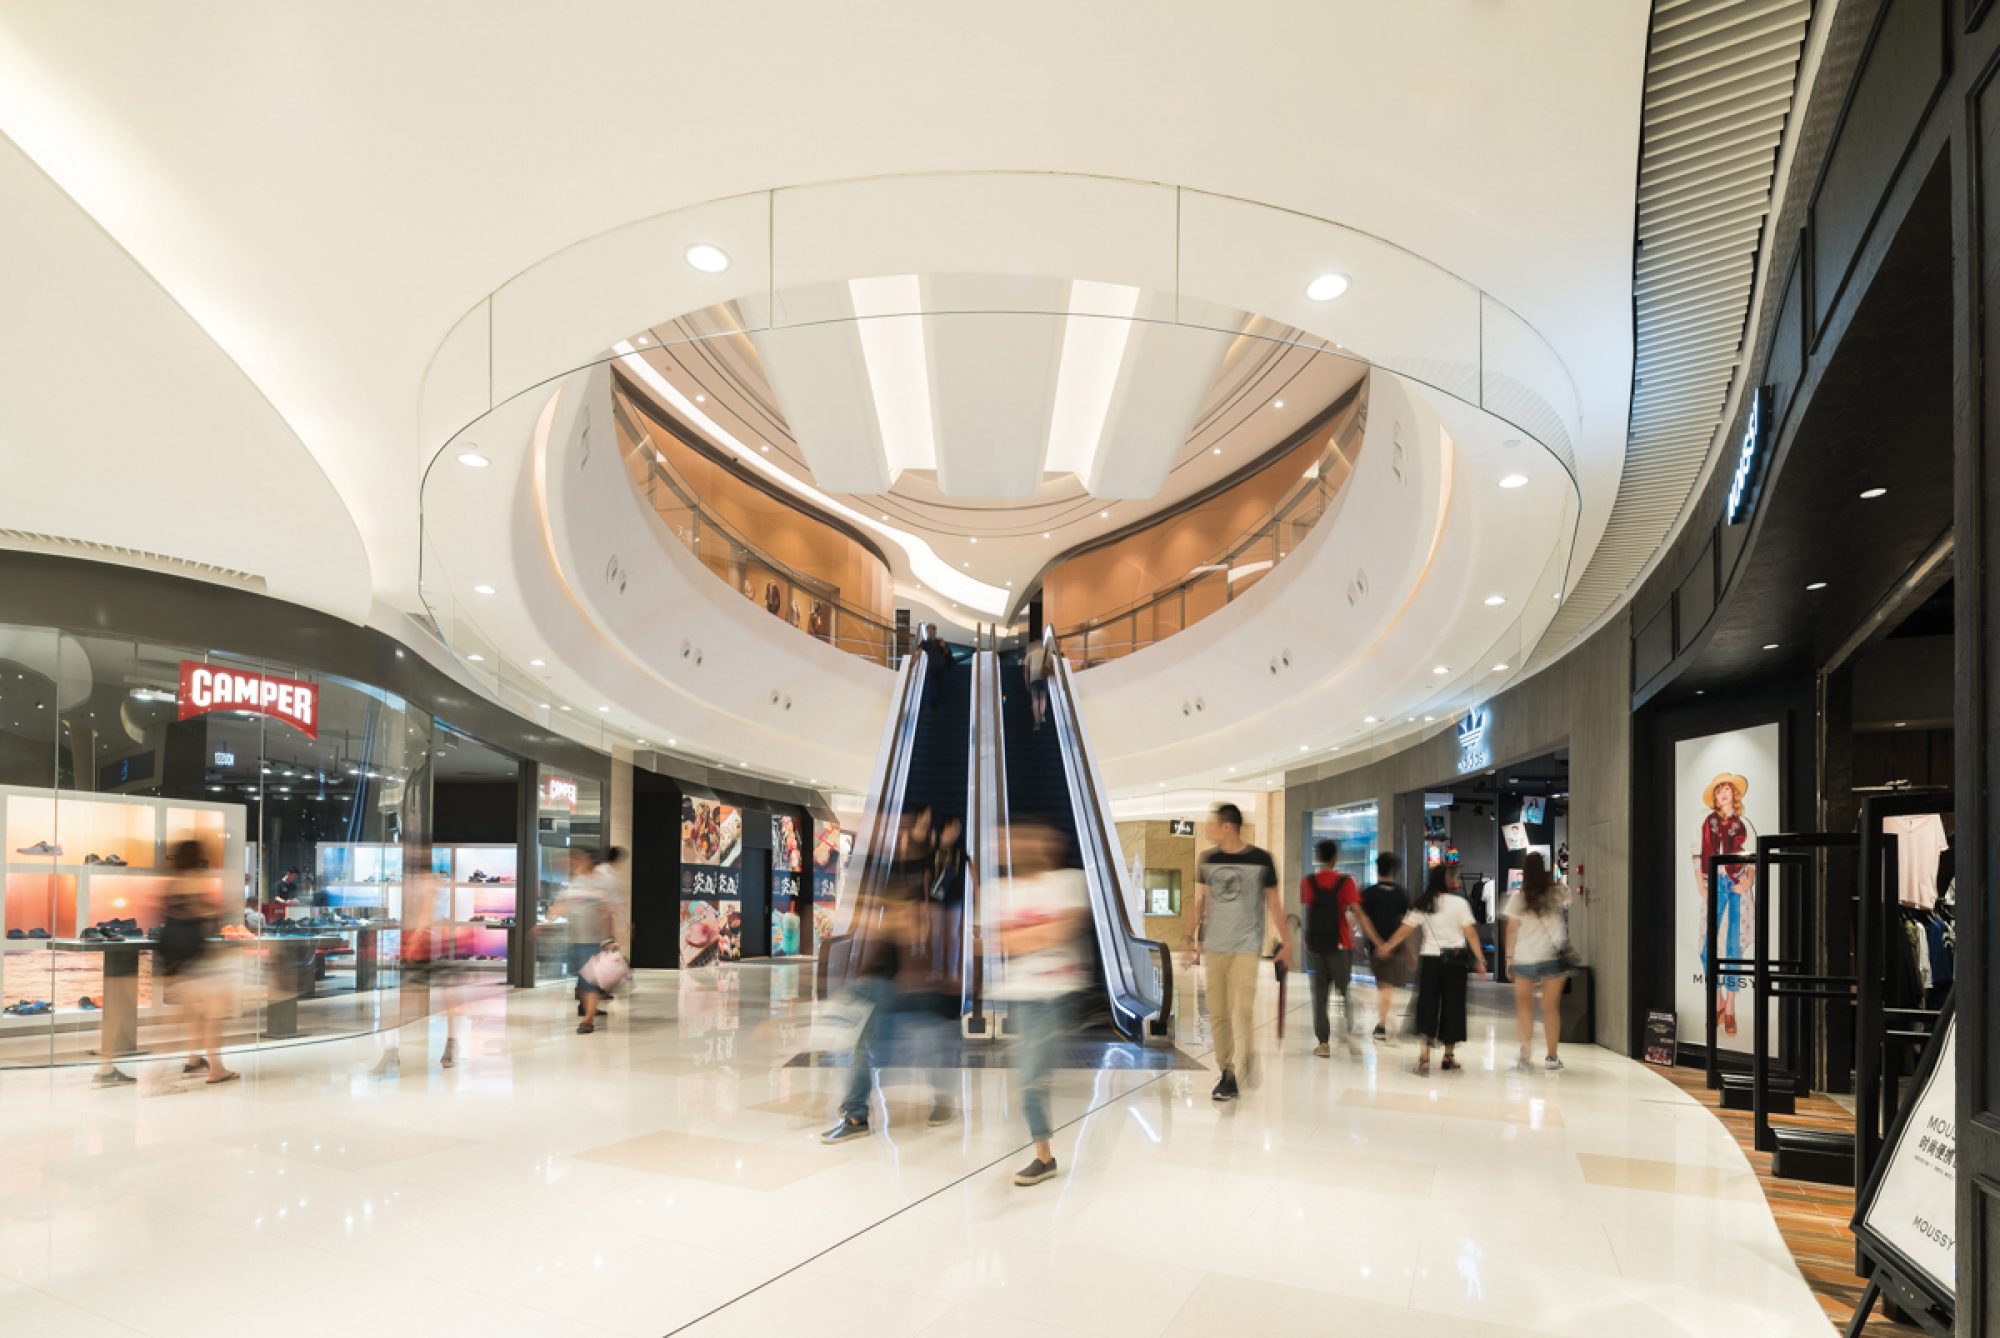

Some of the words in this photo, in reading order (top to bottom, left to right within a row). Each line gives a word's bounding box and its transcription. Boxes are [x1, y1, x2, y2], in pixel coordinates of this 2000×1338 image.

[191, 668, 312, 725] CAMPER
[1918, 1134, 1956, 1169] 时尚便携
[1912, 1214, 1958, 1251] MOUSSY
